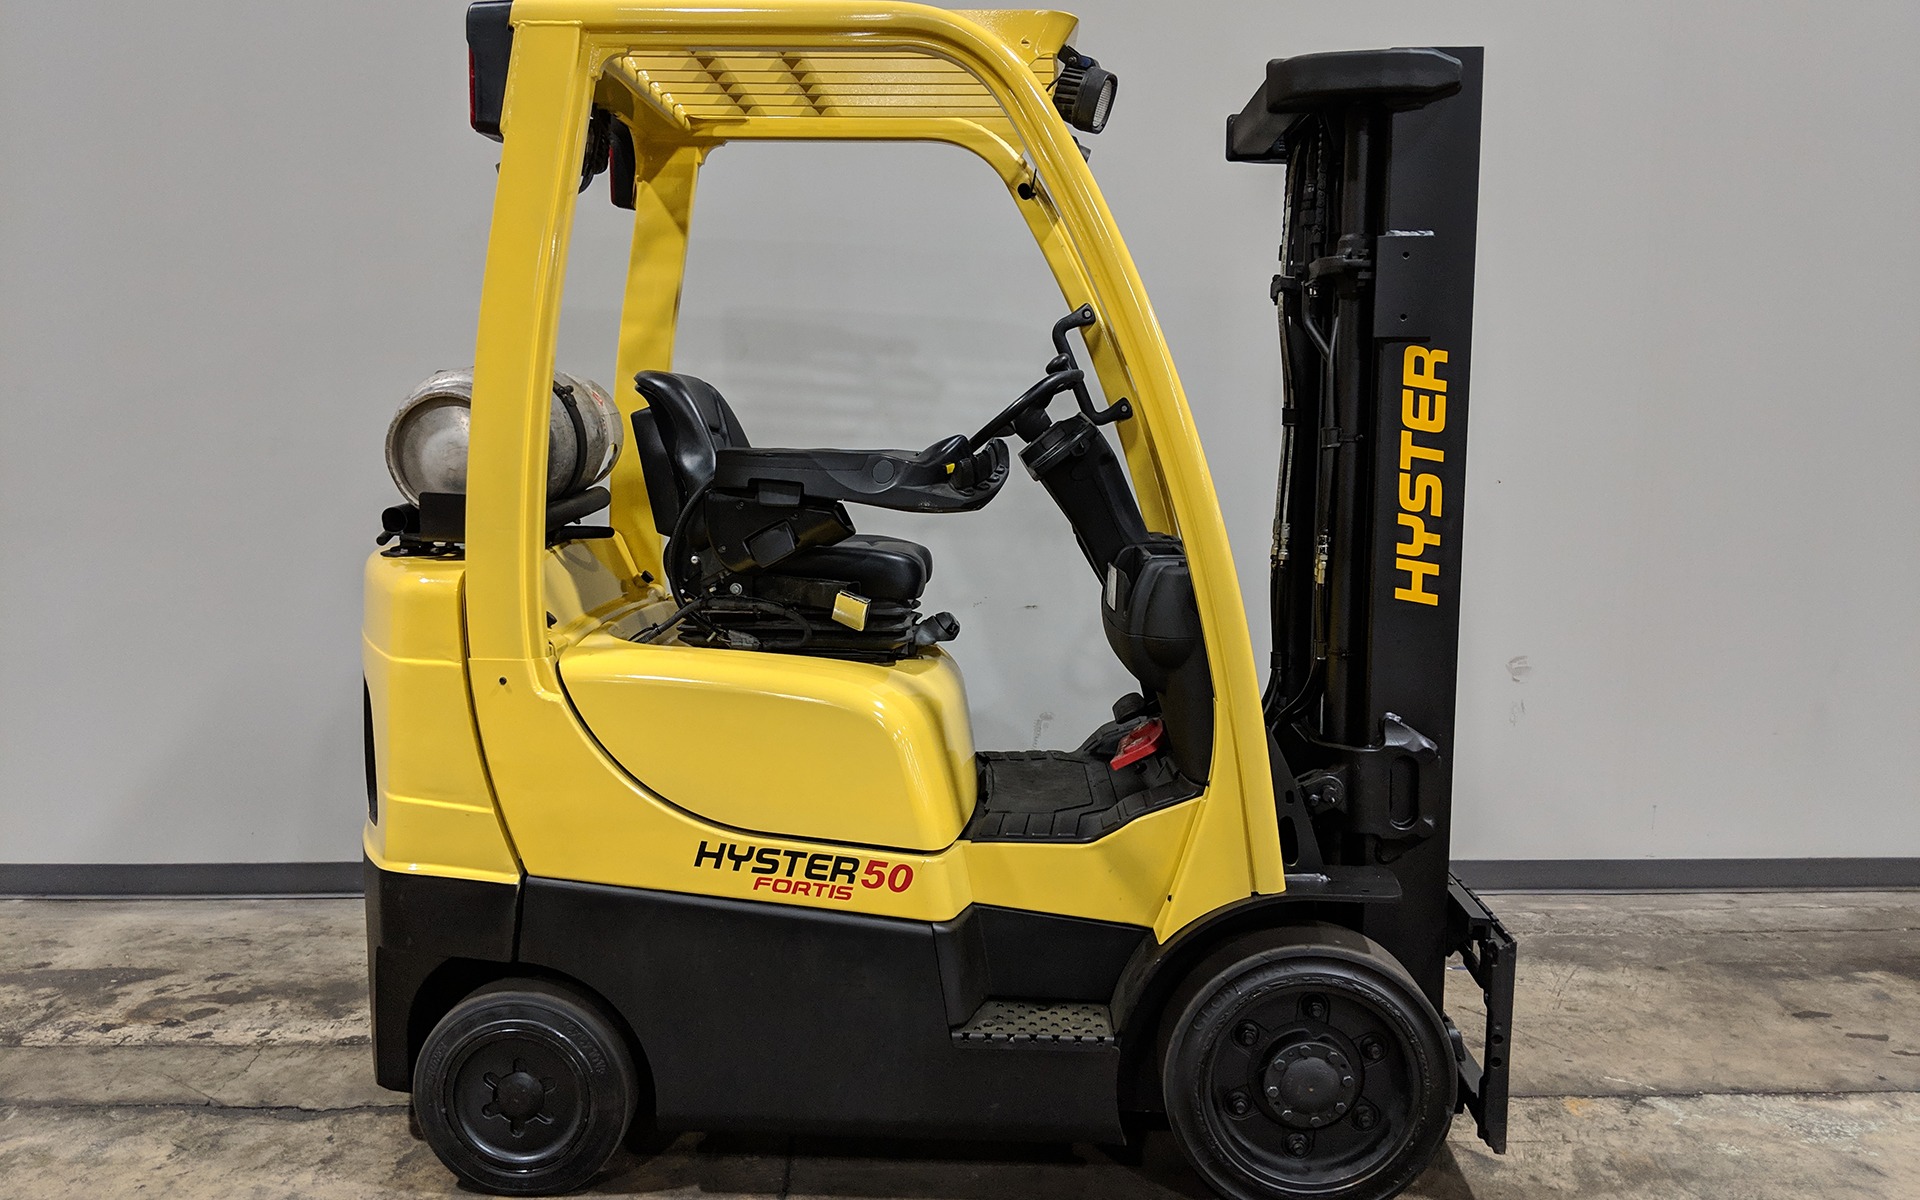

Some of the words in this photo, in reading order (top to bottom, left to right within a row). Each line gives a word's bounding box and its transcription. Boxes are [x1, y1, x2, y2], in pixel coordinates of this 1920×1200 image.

[1394, 345, 1449, 606] HYSTER
[694, 841, 860, 885] HYSTER
[861, 860, 914, 893] 50
[753, 877, 854, 900] FORTIS
